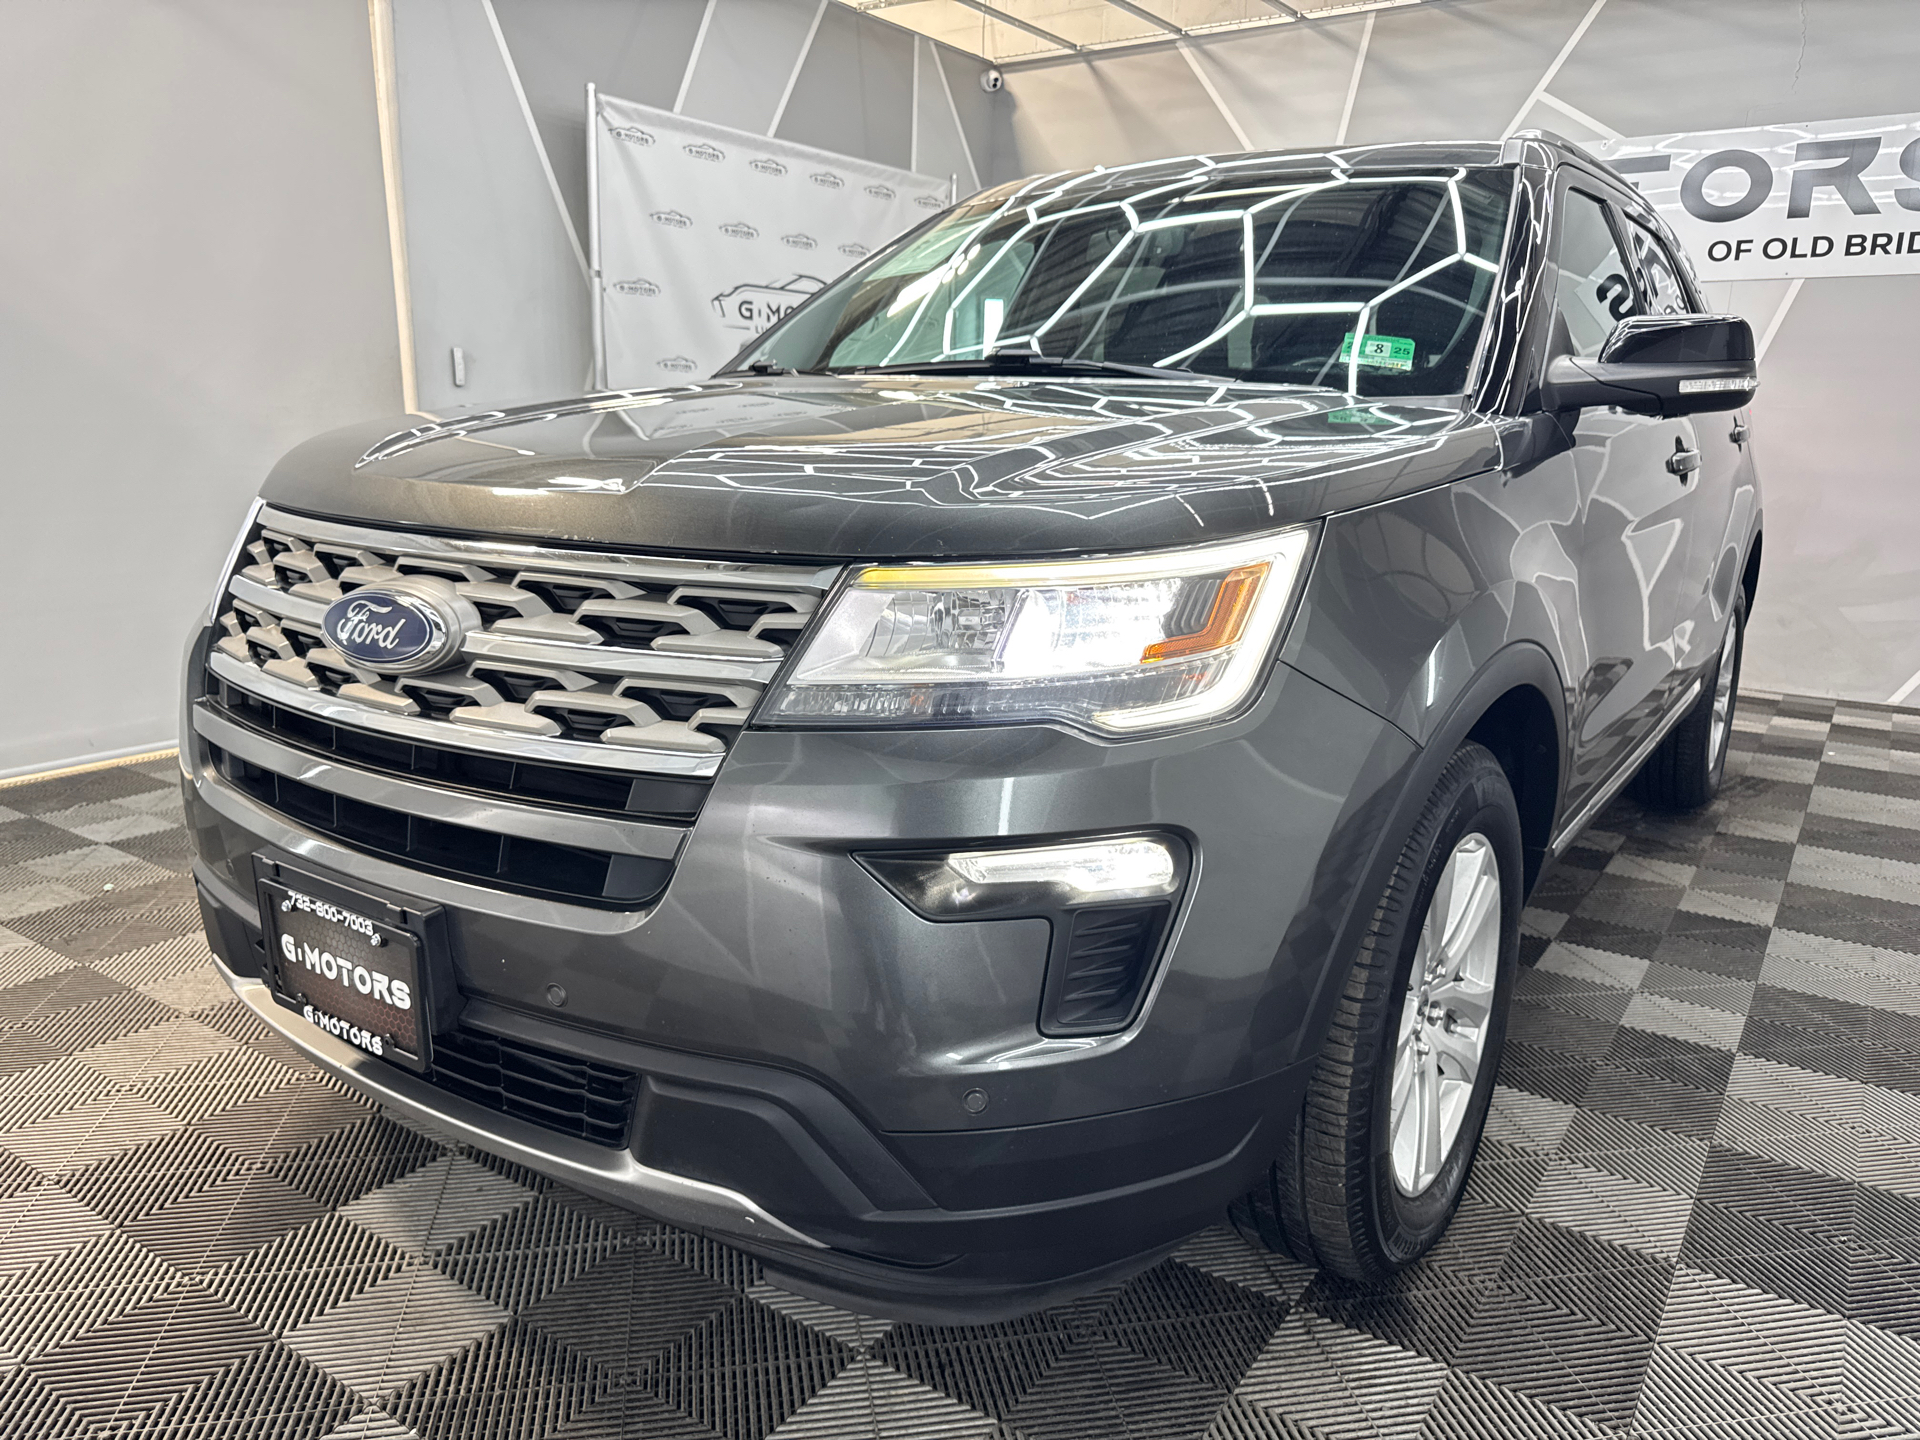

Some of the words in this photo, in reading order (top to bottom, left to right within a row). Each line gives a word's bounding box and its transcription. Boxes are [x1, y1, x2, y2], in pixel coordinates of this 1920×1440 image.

[1708, 239, 1754, 262] OF
[1762, 235, 1834, 260] OLD
[1374, 343, 1384, 354] 8
[1393, 346, 1410, 355] 25
[336, 600, 406, 650] Ford
[287, 891, 374, 936] 732-800-7003
